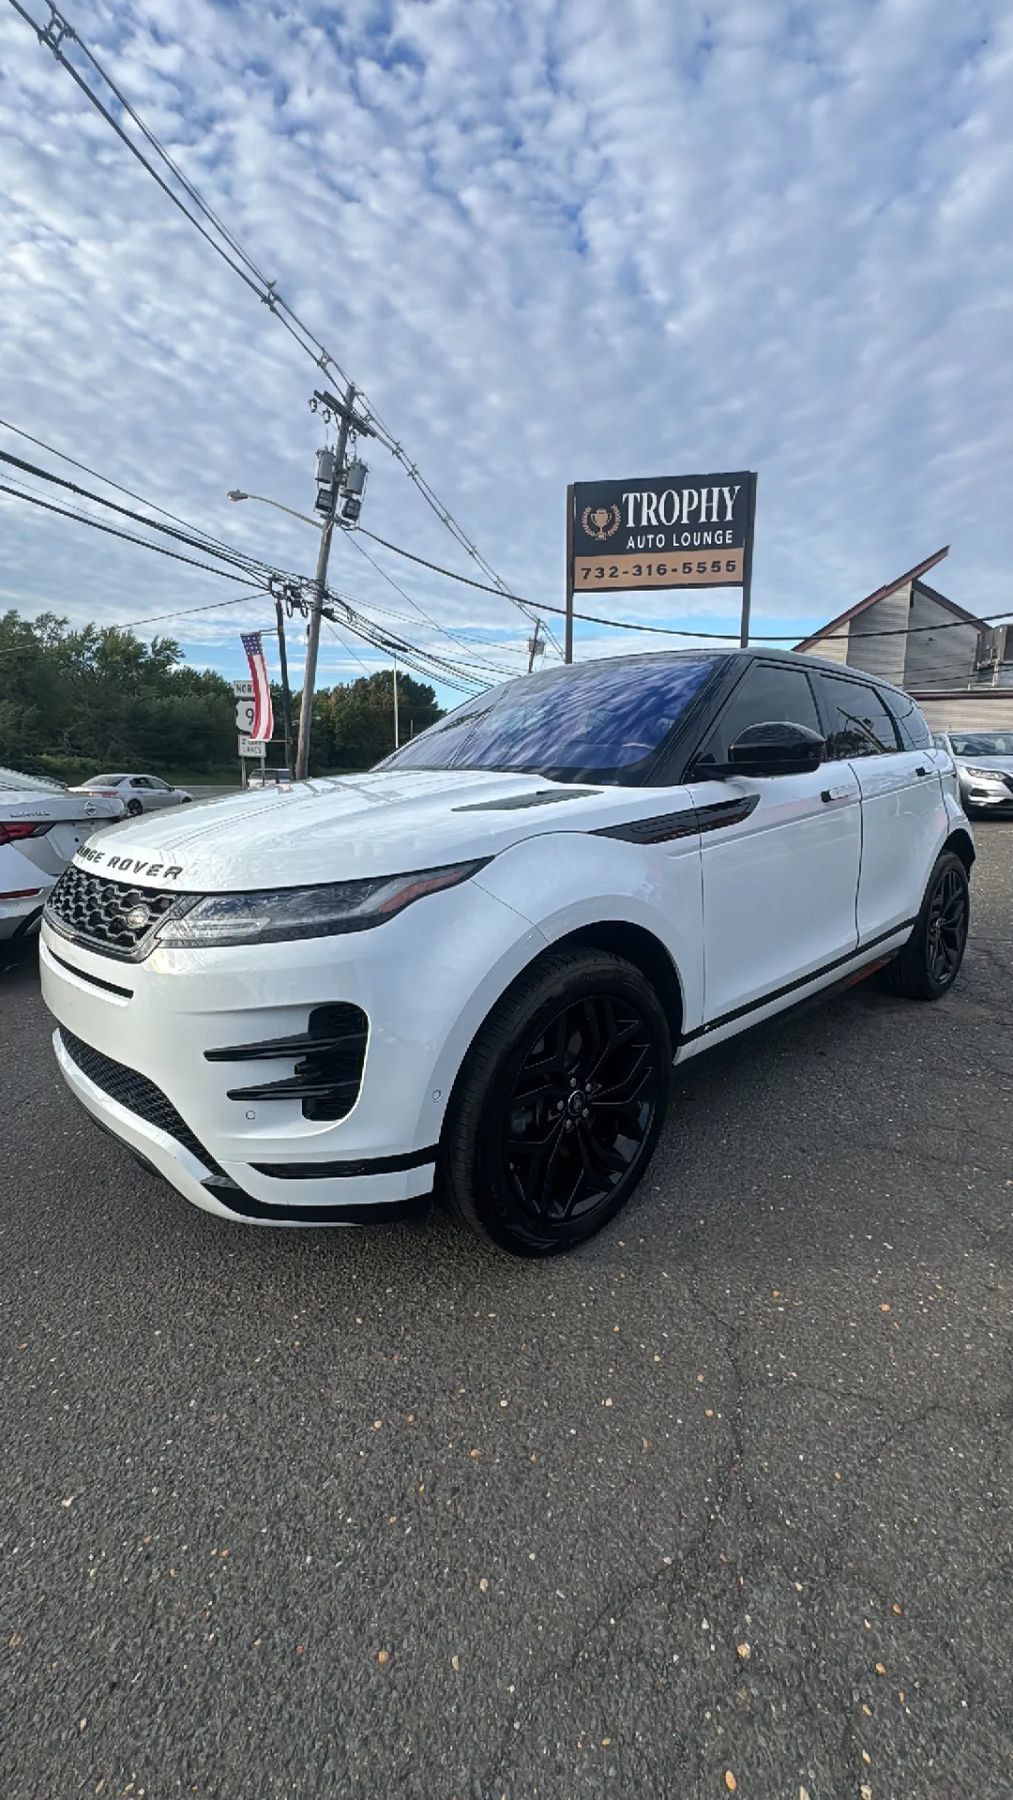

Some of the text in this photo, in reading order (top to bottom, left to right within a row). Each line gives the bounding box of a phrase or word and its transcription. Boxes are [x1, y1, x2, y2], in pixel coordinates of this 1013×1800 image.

[622, 485, 742, 528] TROPHY
[626, 530, 734, 550] AUTO LOUNGE
[581, 560, 737, 581] 732-316-5555
[236, 683, 253, 694] NOR
[245, 708, 255, 726] 9
[106, 856, 183, 880] ROVER
